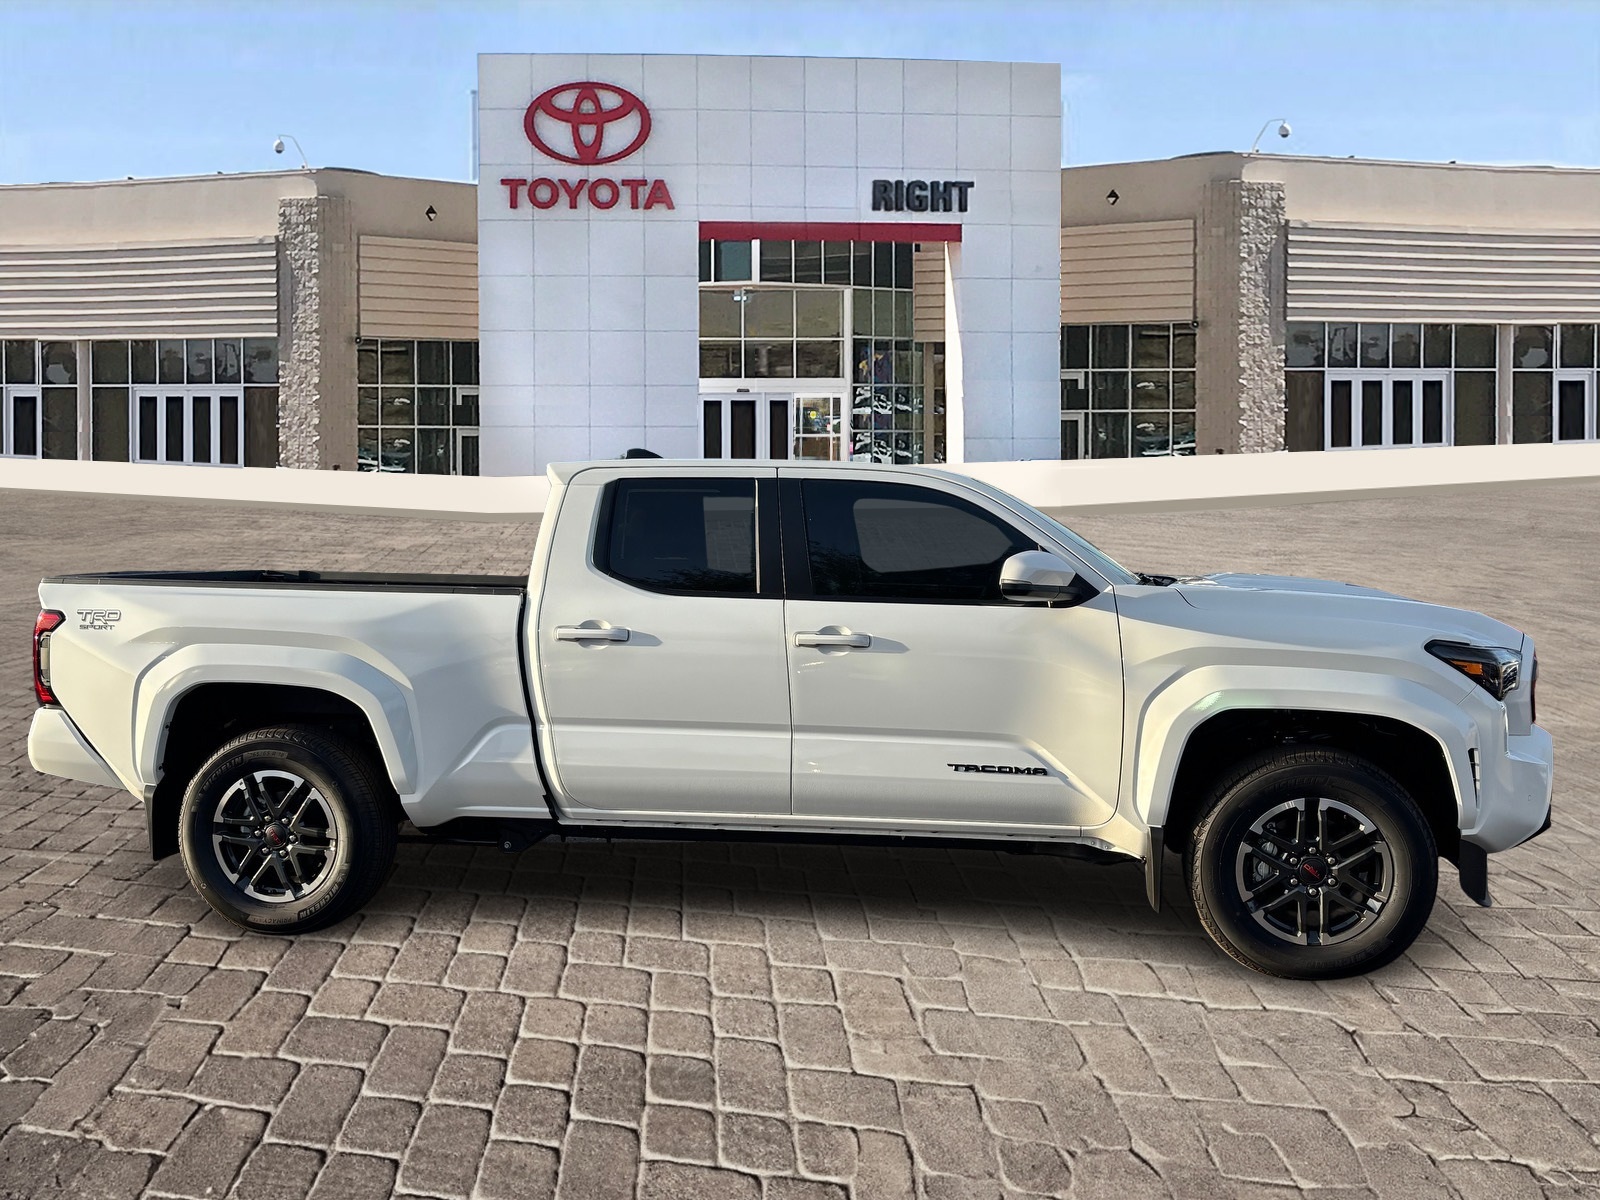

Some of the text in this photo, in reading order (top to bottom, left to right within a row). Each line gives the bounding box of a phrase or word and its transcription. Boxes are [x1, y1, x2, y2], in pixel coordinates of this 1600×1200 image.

[500, 177, 675, 210] TOYOTA
[871, 179, 975, 213] RIGHT
[77, 608, 122, 625] TRD
[202, 756, 243, 792] MICHELIN
[946, 763, 1048, 776] TACOMA
[298, 882, 339, 920] MICHELIN
